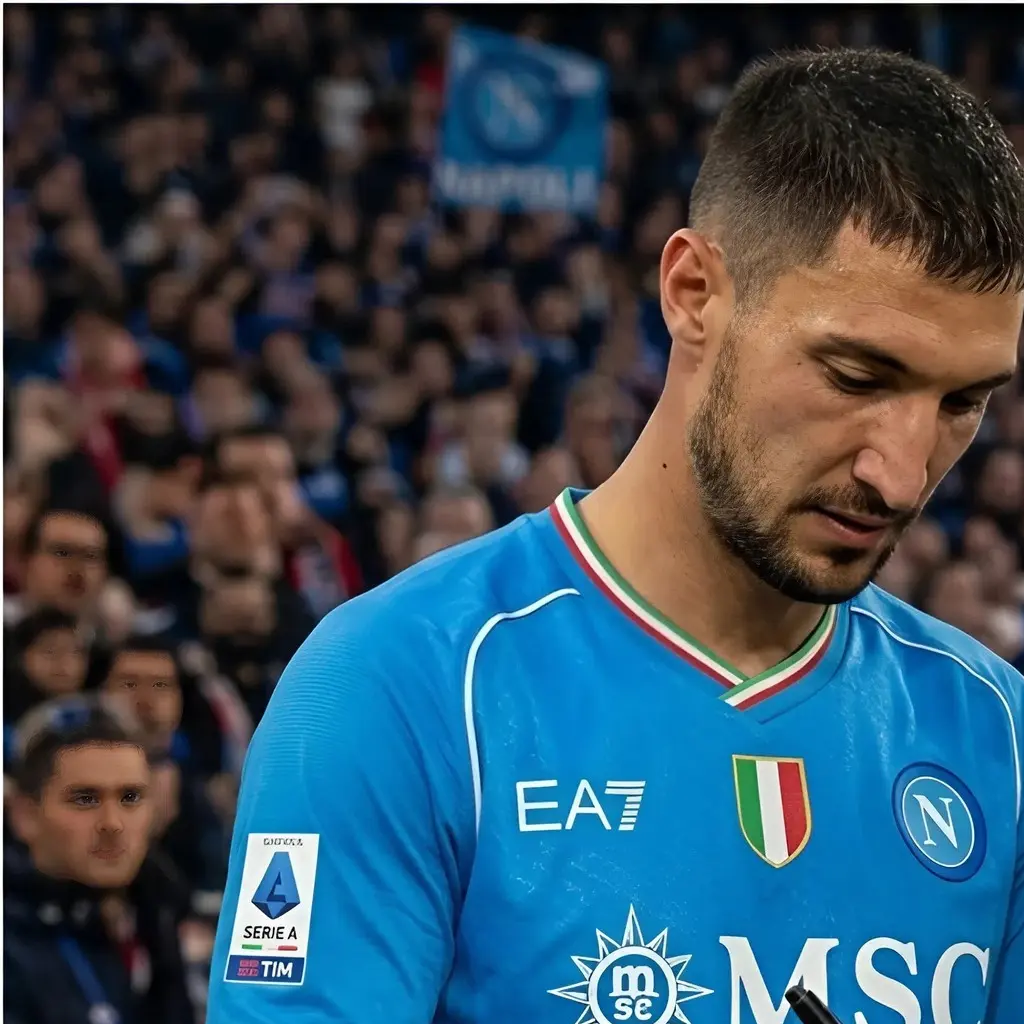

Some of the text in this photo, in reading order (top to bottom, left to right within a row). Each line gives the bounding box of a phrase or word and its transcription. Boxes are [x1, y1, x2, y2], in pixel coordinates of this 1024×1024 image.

[515, 779, 646, 832] EA7
[912, 792, 957, 848] N
[287, 926, 298, 940] A
[261, 960, 294, 979] TIM
